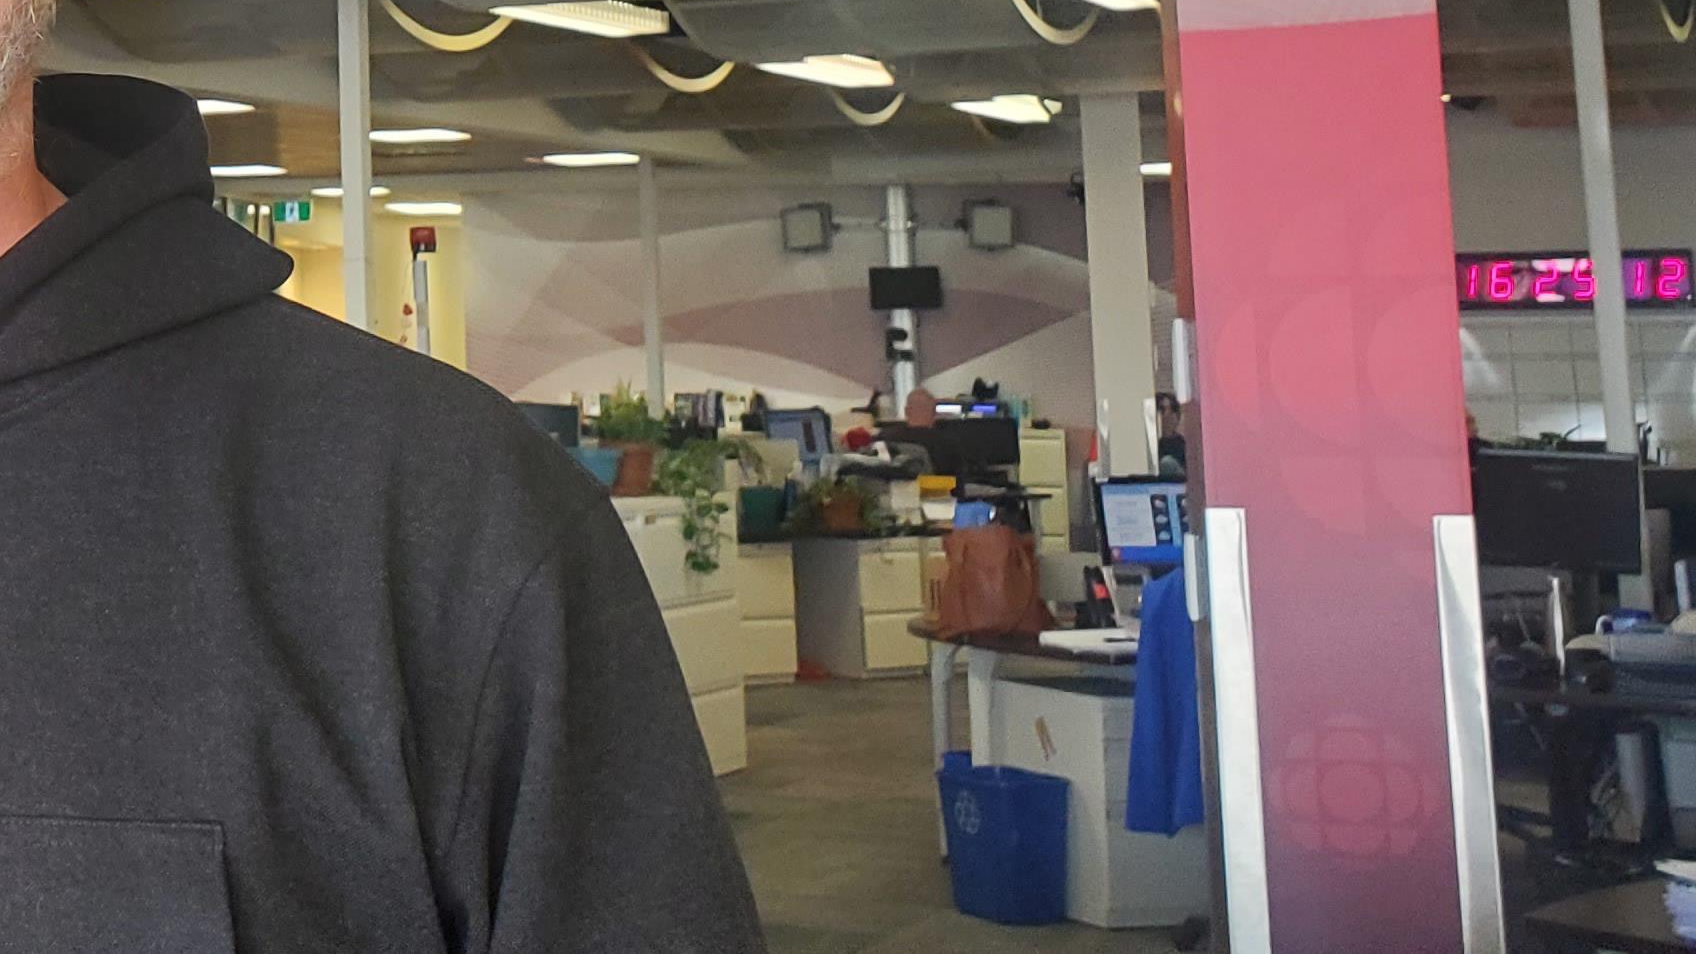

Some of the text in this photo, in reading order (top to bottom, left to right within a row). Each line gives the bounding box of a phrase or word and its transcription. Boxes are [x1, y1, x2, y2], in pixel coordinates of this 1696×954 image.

[1466, 256, 1686, 301] 16 25 12
